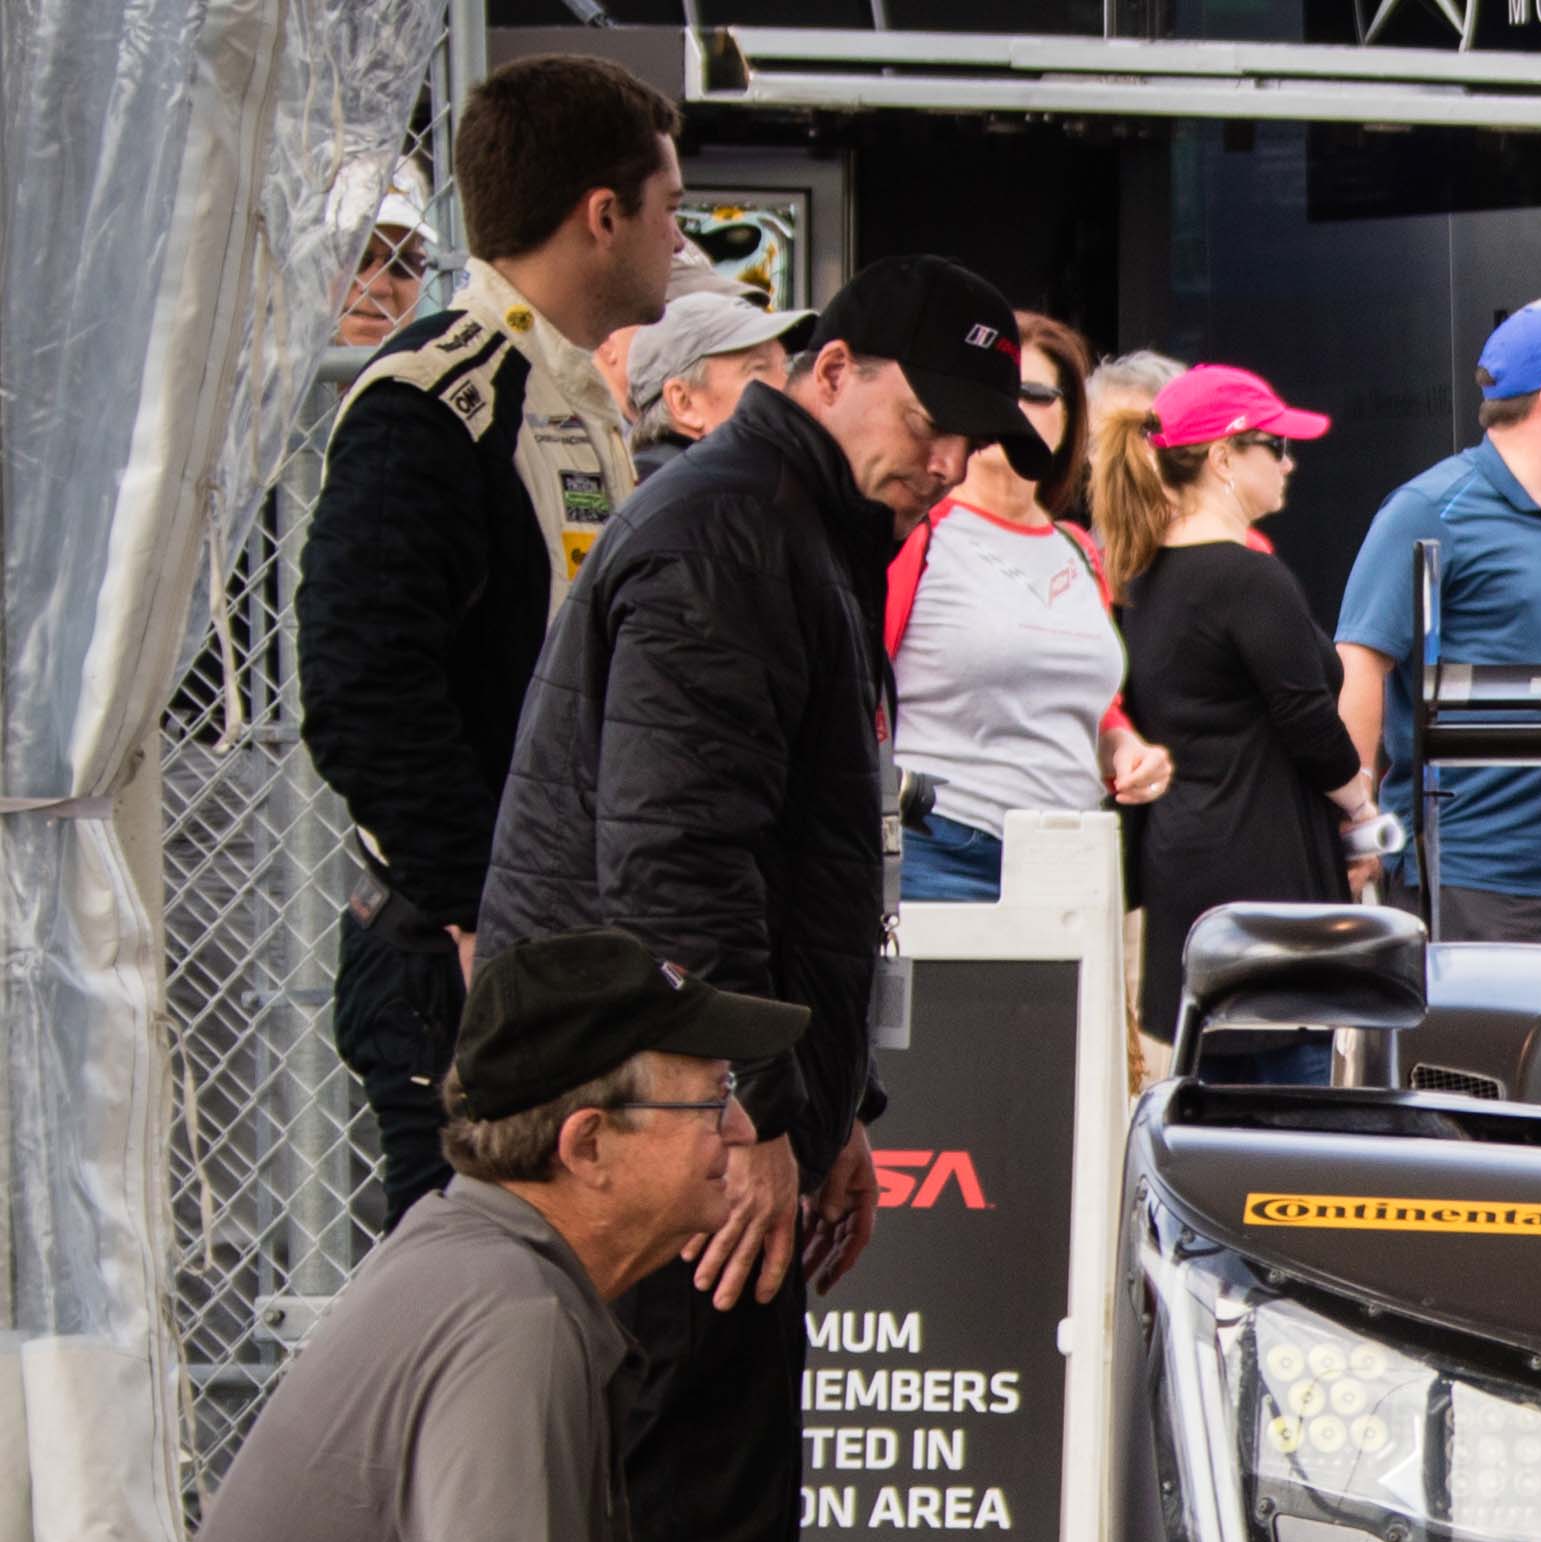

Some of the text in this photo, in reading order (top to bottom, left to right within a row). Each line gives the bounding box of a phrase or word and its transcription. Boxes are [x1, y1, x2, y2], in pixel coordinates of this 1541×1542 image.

[869, 1149, 987, 1209] SA
[804, 1311, 921, 1354] MUM
[801, 1369, 1020, 1414] EMBERS
[801, 1427, 964, 1471] TED IN
[868, 1486, 1012, 1529] AREA
